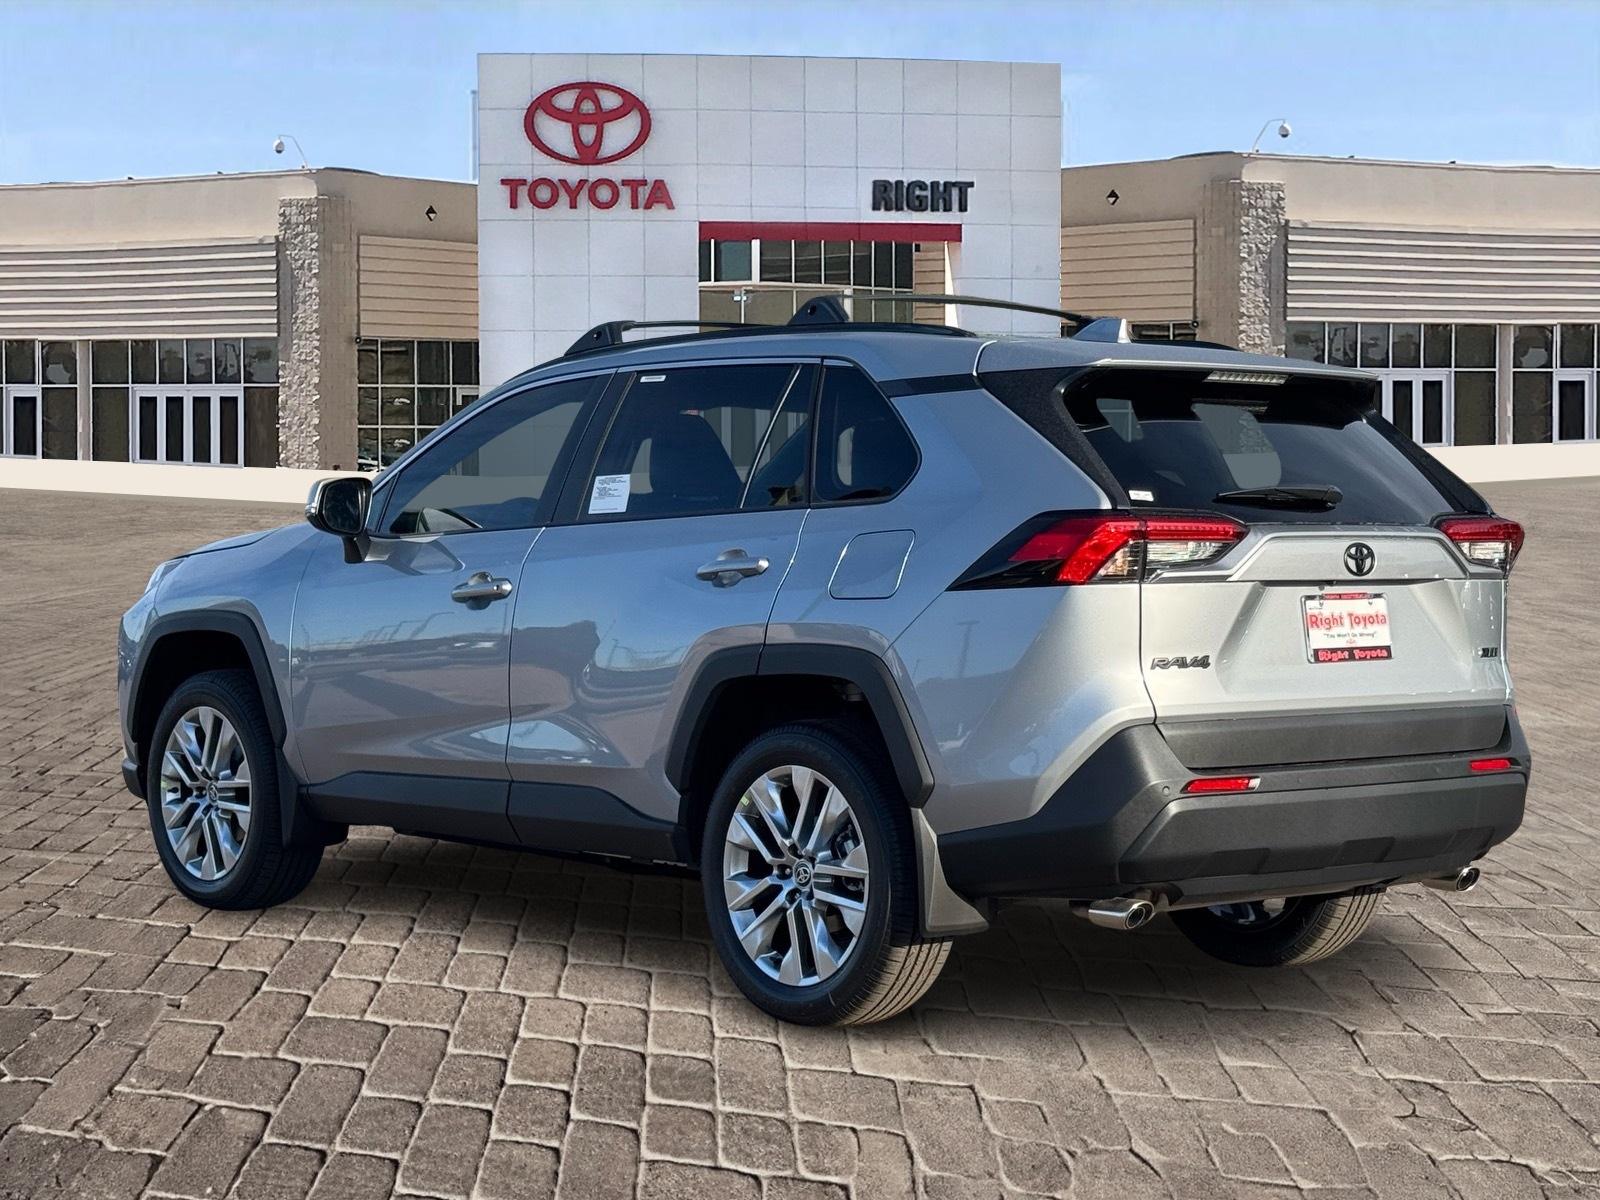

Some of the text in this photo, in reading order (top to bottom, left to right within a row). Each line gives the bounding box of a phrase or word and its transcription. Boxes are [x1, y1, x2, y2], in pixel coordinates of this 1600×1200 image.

[500, 178, 675, 210] TOYOTA
[872, 180, 975, 212] RIGHT
[1308, 611, 1387, 630] Right Toyota
[1150, 655, 1211, 670] RAV4
[1318, 649, 1387, 661] Right Toyota
